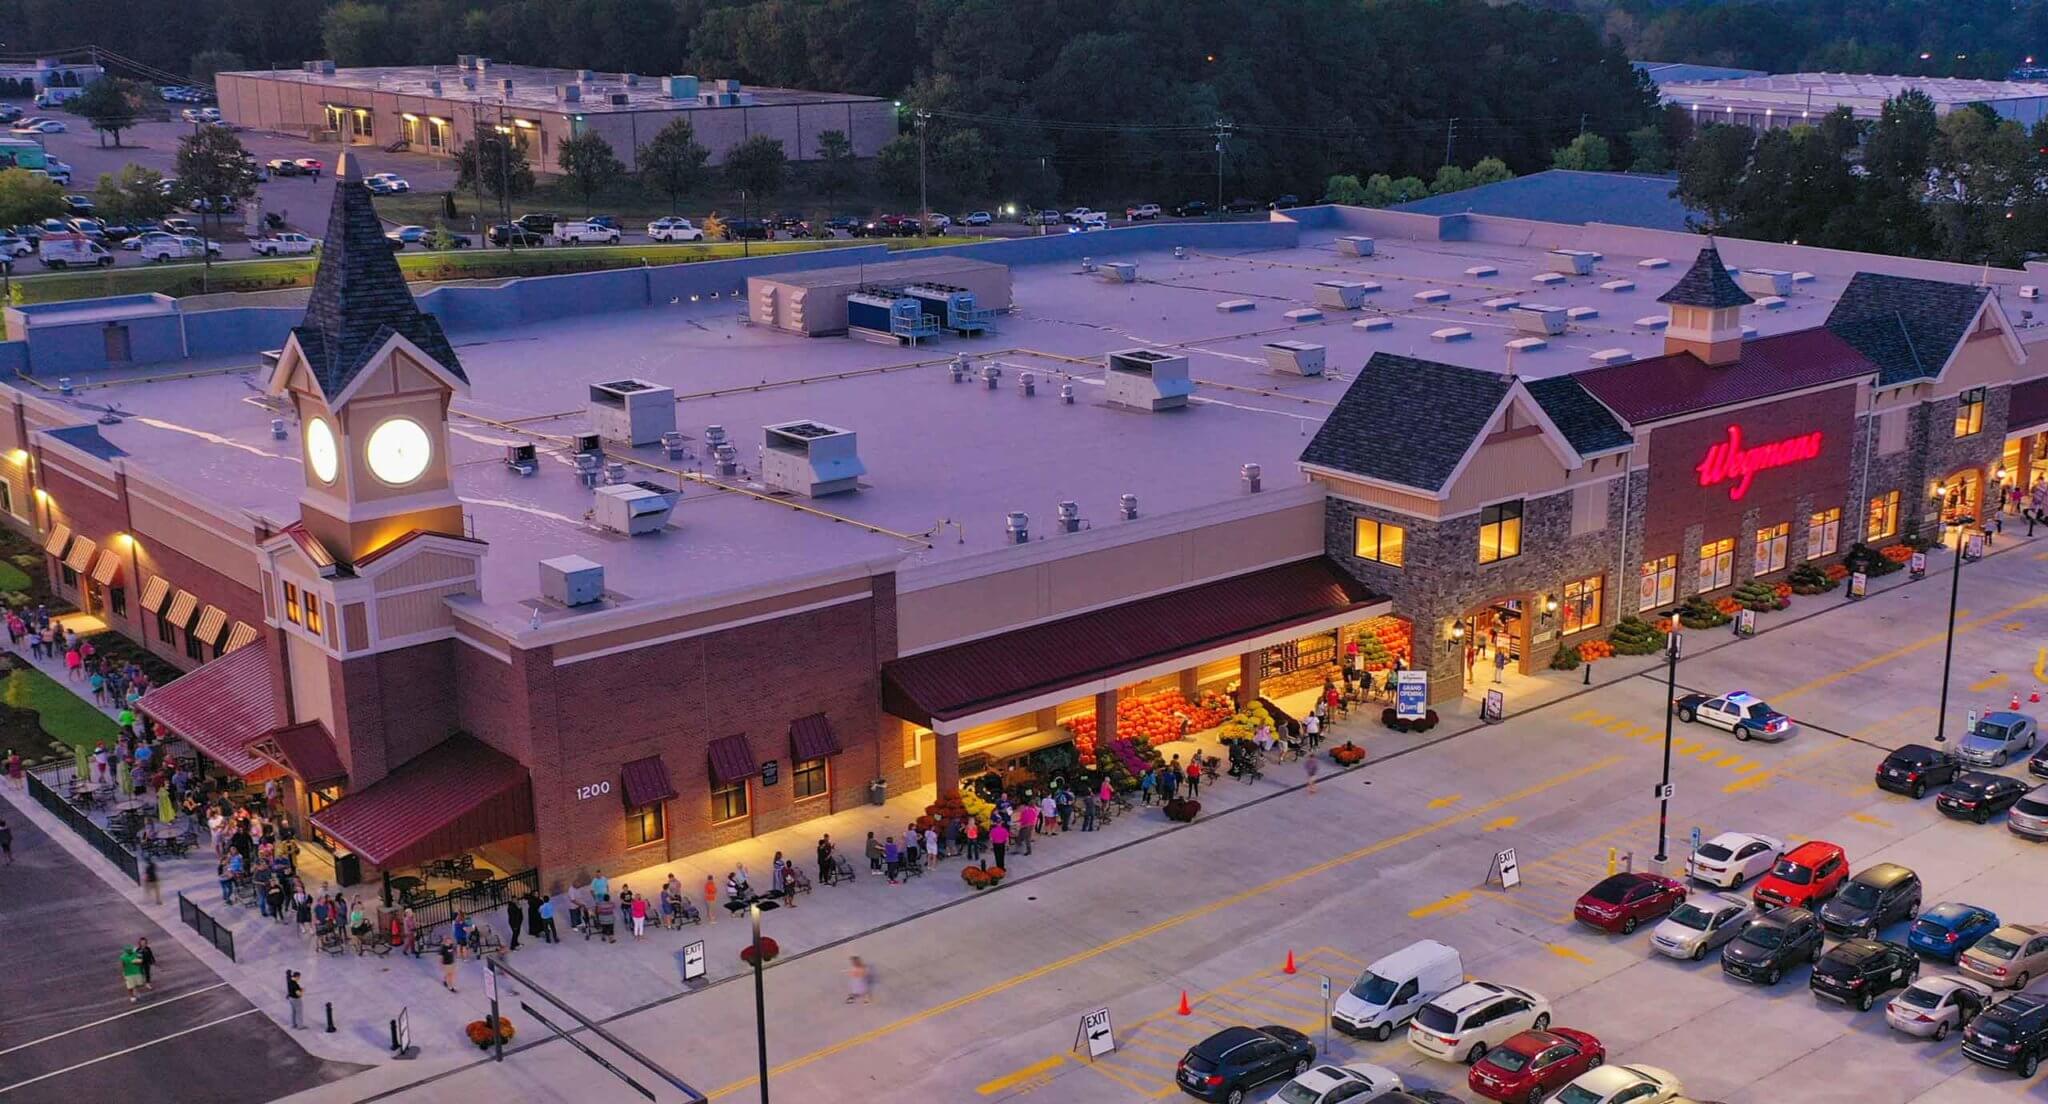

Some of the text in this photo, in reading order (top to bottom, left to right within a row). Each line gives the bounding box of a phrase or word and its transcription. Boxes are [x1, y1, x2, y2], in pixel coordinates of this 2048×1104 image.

[1696, 424, 1822, 500] Wegmans
[577, 781, 610, 800] 1200
[1664, 785, 1673, 797] 6
[1499, 849, 1514, 864] EXIT
[685, 943, 702, 956] EXIT
[1086, 1010, 1107, 1029] EXIT
